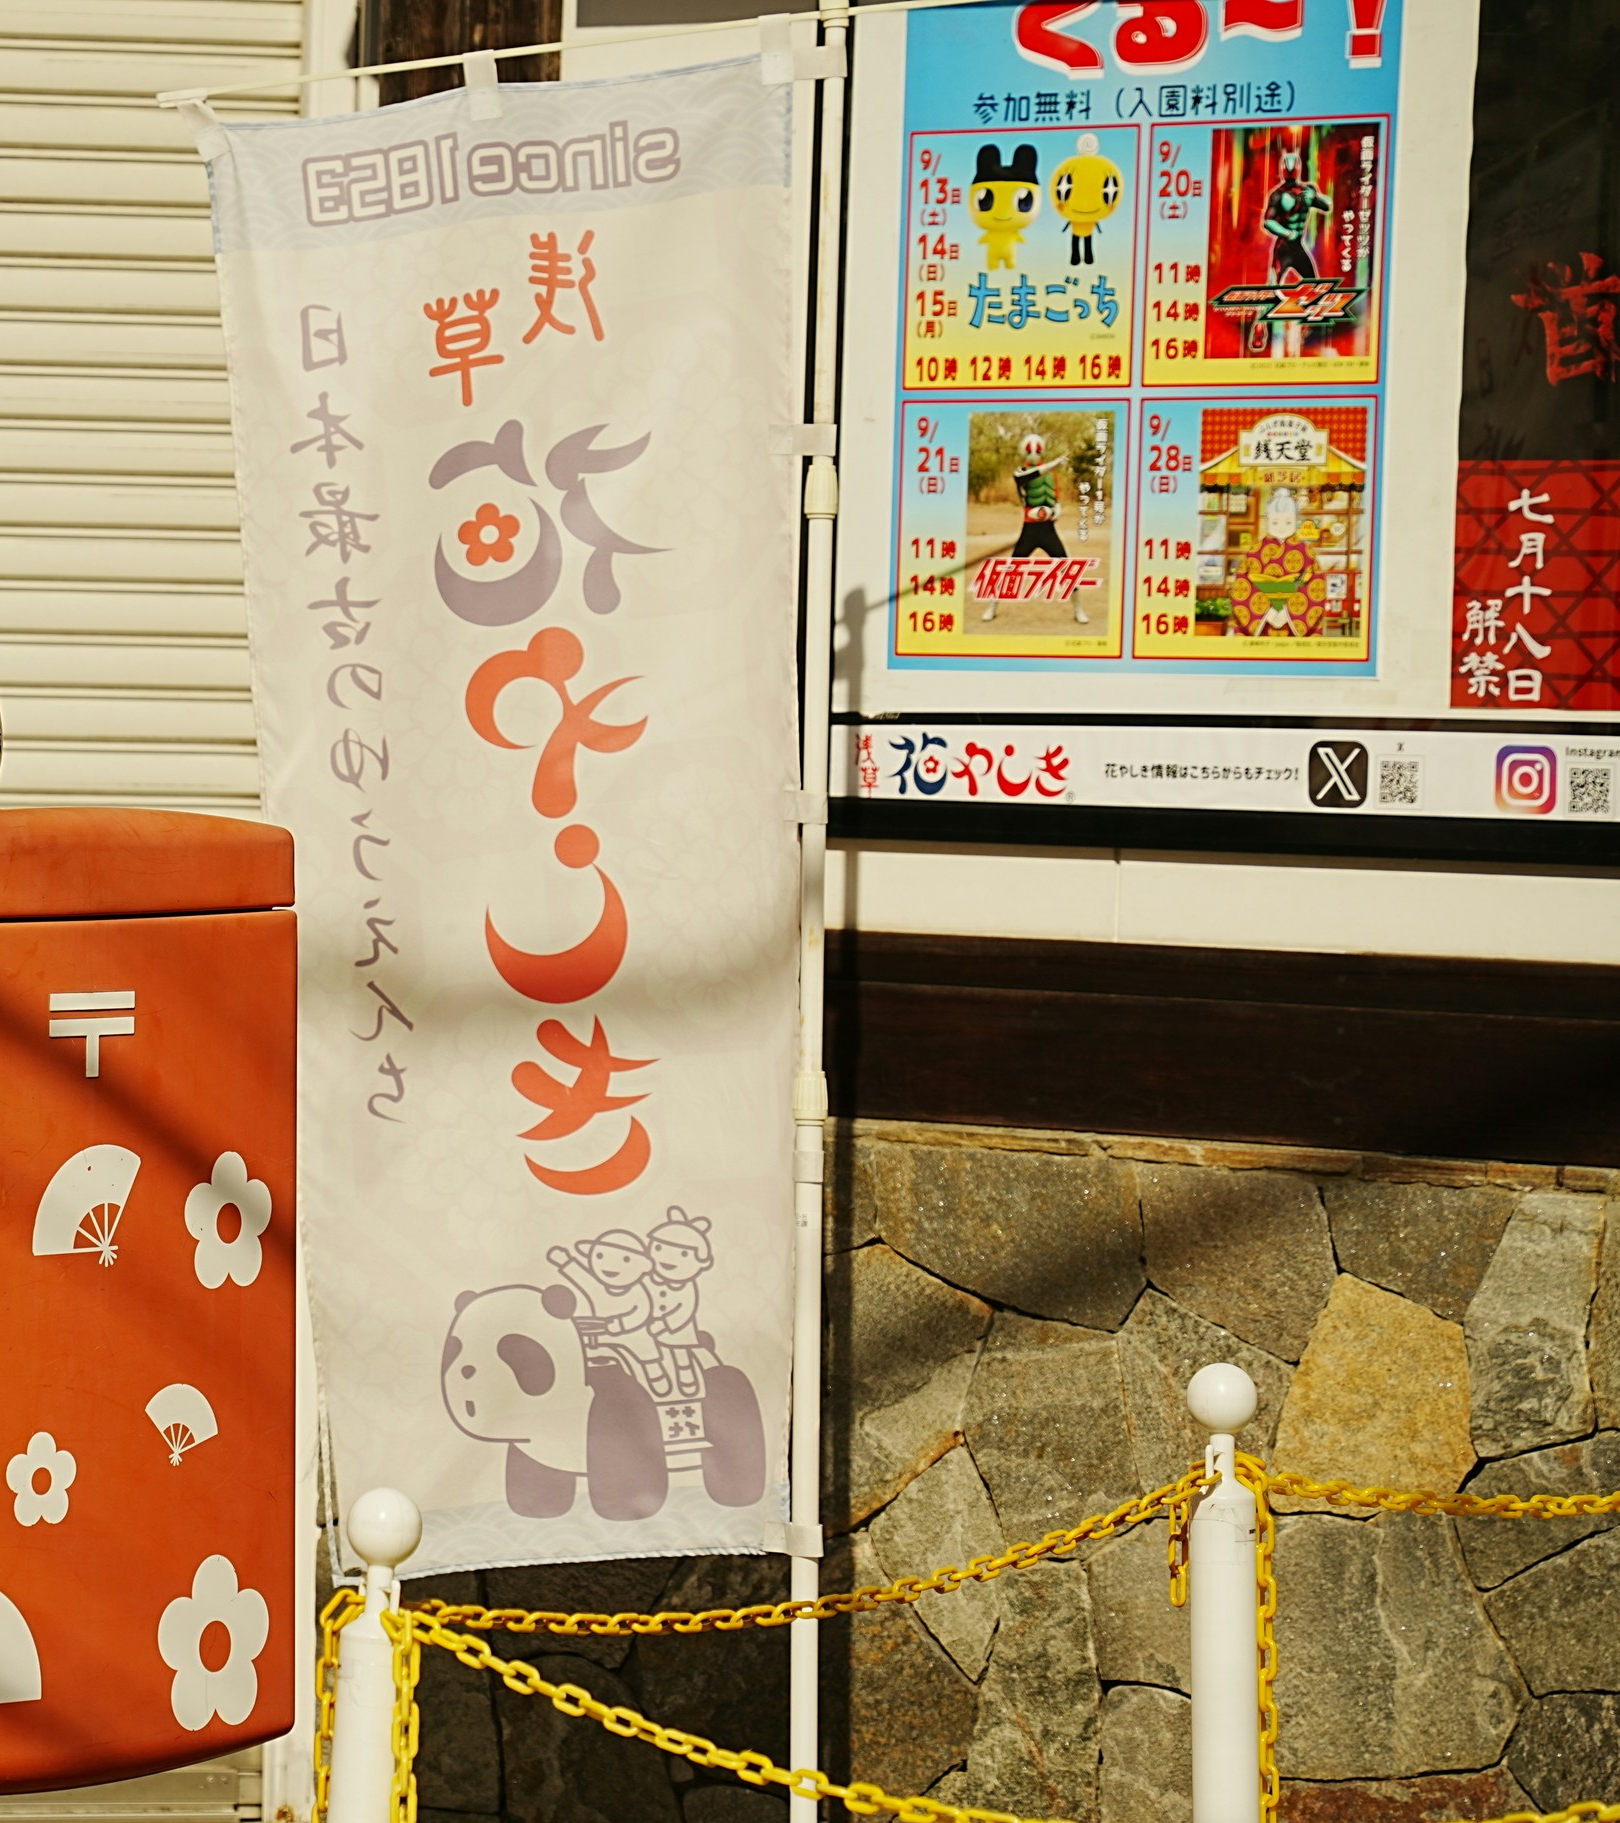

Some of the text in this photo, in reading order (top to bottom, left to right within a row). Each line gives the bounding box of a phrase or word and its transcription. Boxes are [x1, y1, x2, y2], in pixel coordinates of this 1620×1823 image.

[919, 177, 962, 205] 13日
[1158, 169, 1203, 198] 20日
[917, 232, 960, 260] 14日
[1341, 210, 1355, 272] やってくる
[1154, 262, 1201, 284] 11時
[916, 290, 957, 317] 15日
[968, 272, 1120, 330] たまごっち
[1153, 300, 1199, 322] 14時
[1152, 338, 1198, 360] 16時
[917, 447, 960, 473] 21日
[1148, 445, 1193, 473] 28日
[911, 538, 957, 559] 11時
[1144, 538, 1191, 560] 11時
[910, 575, 955, 596] 14時
[968, 557, 1103, 602] 仮面ライダー
[1143, 576, 1190, 598] 14時
[1503, 488, 1555, 702] 七月十八日
[909, 612, 954, 633] 16時
[1142, 614, 1189, 635] 16時
[1458, 599, 1505, 698] 解禁
